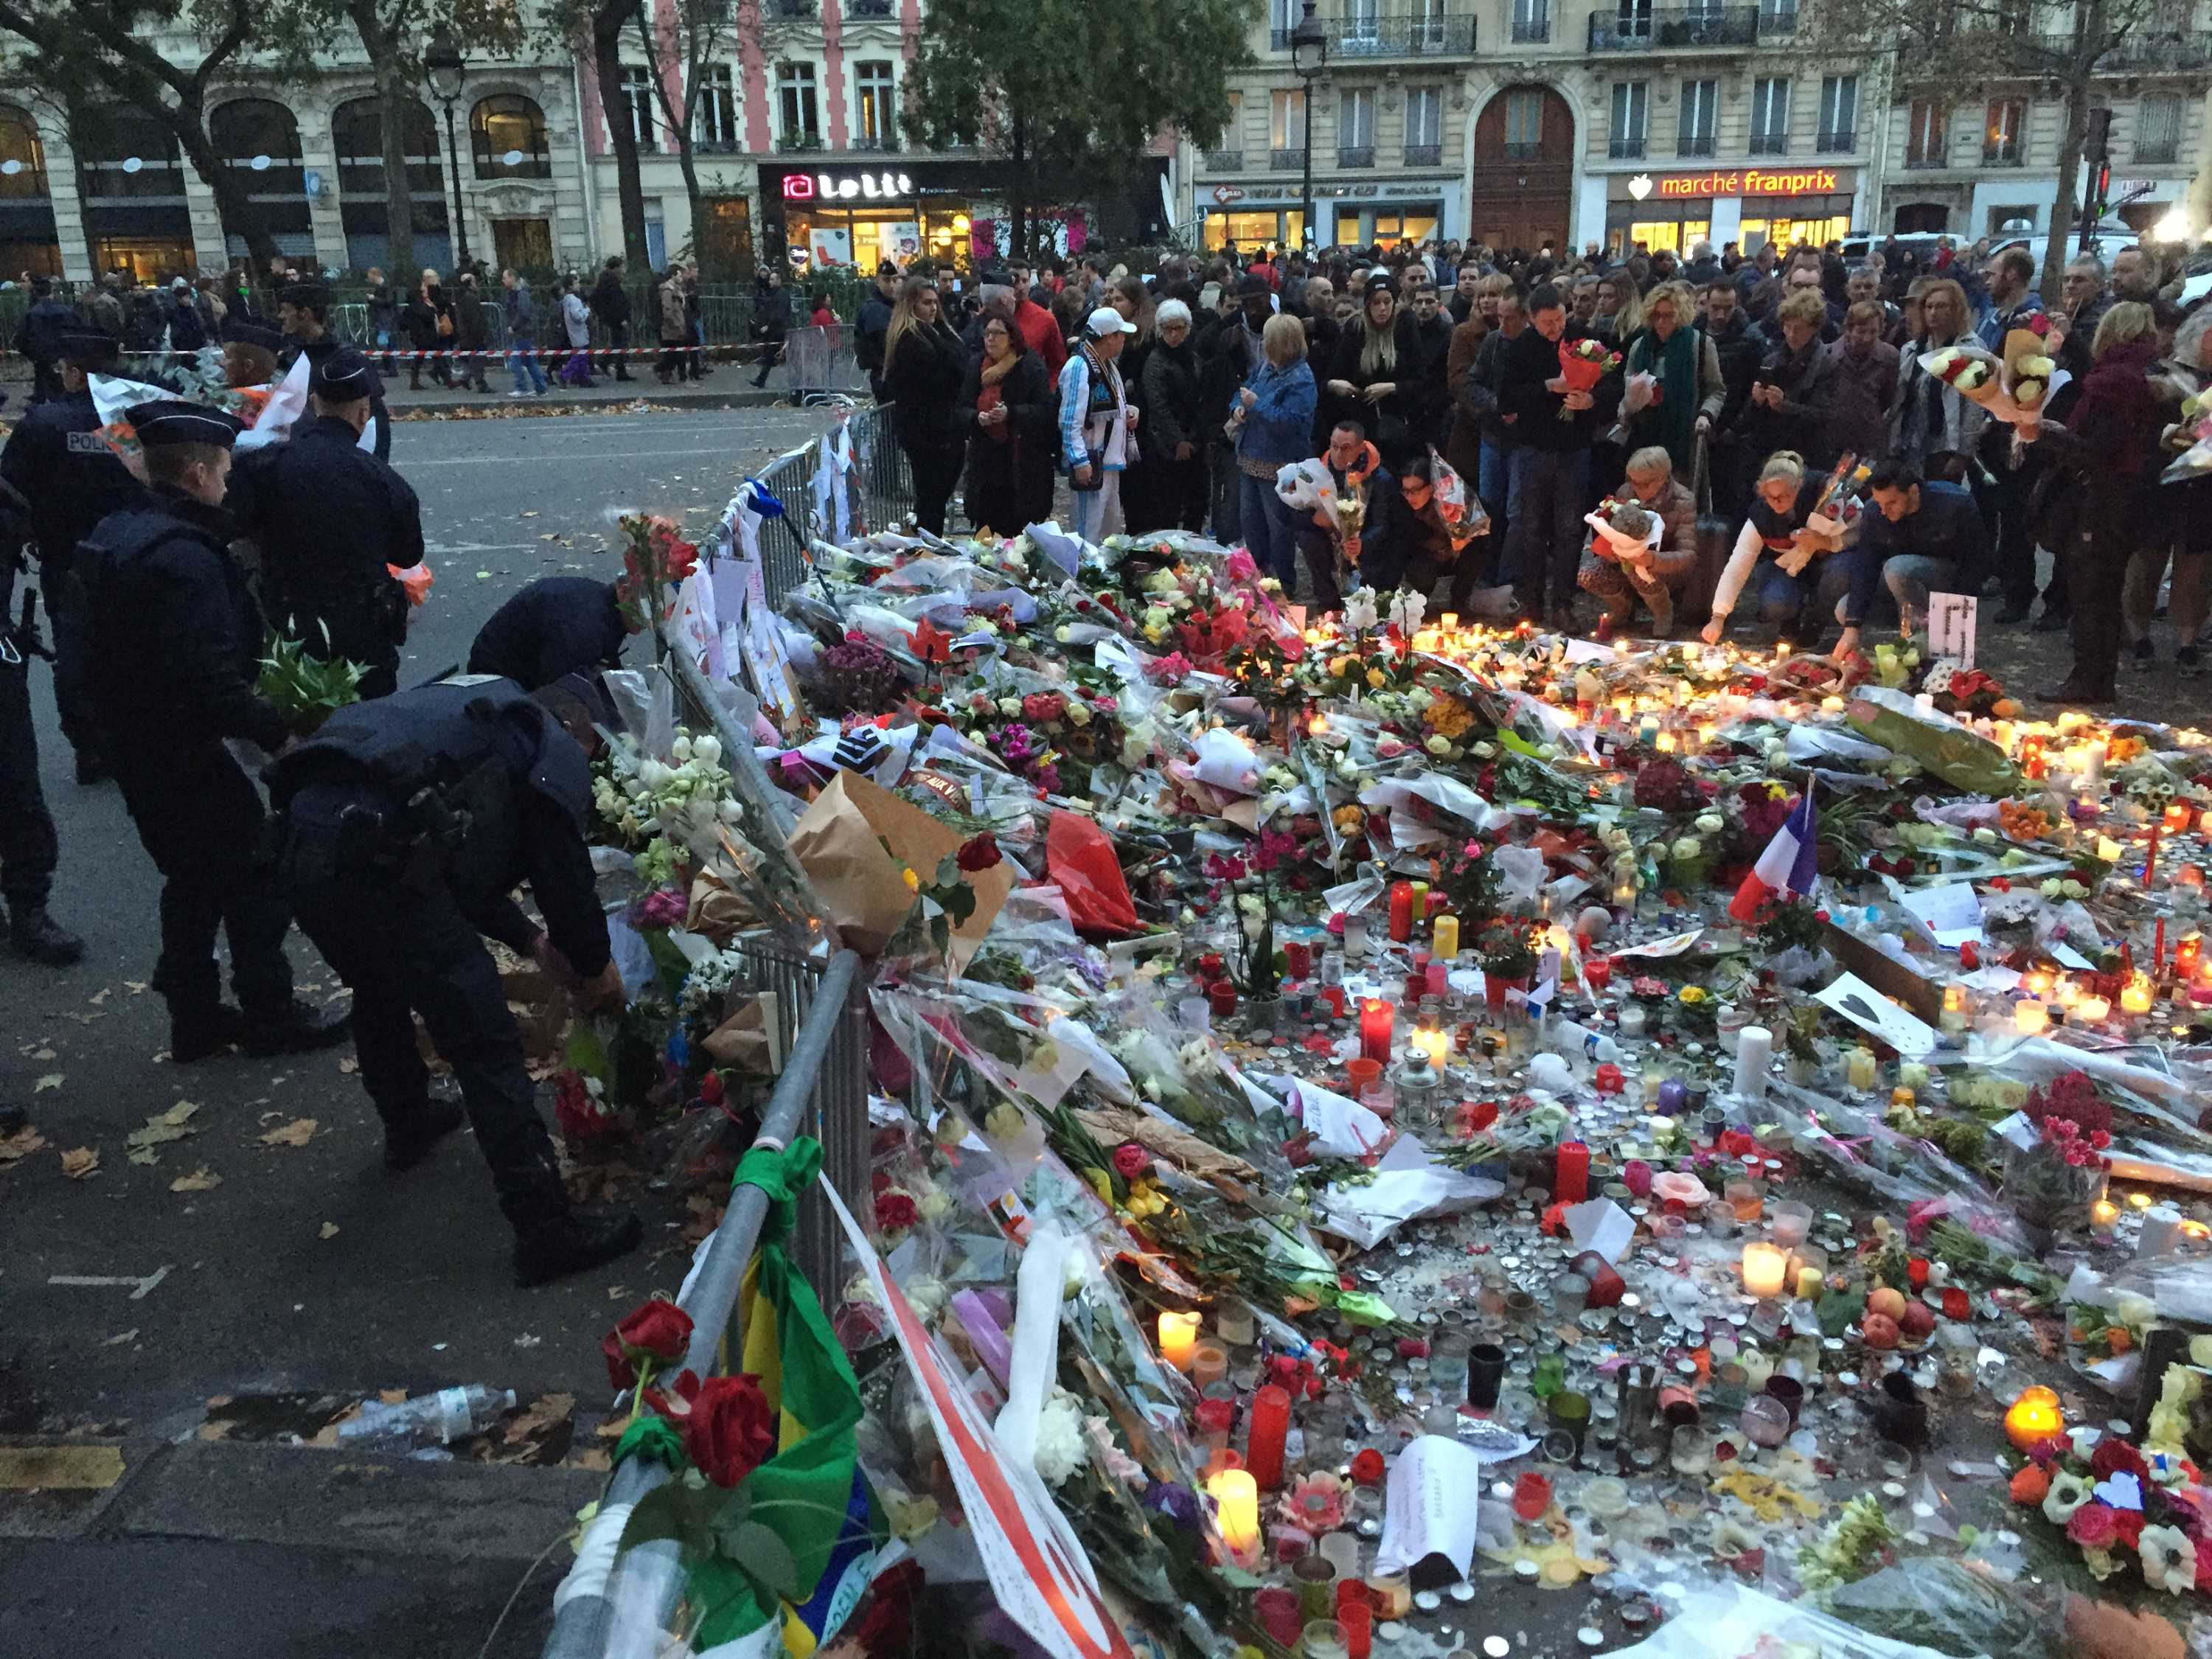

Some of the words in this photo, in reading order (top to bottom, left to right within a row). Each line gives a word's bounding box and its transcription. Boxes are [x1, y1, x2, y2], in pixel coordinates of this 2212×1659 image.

[1661, 172, 1739, 194] marché
[1745, 170, 1836, 195] franprix
[69, 433, 112, 451] POLI
